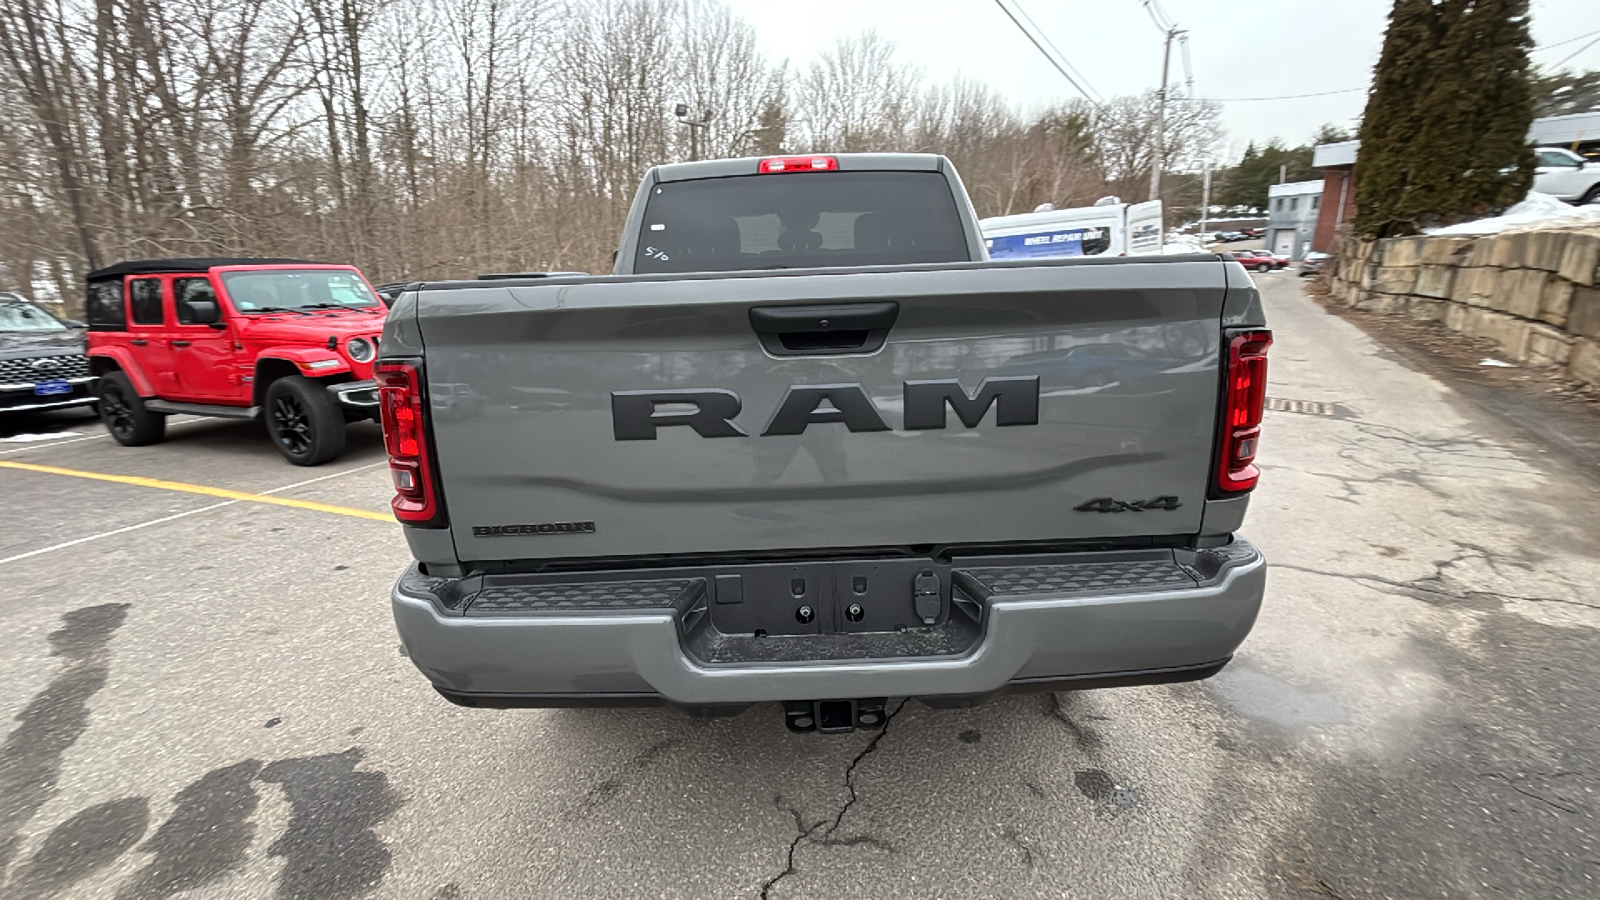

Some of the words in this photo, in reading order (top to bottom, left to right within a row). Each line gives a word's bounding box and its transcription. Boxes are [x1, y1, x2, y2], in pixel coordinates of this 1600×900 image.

[1024, 236, 1051, 246] WHEEL
[1052, 233, 1082, 243] REPAIR
[610, 375, 1040, 441] RAM
